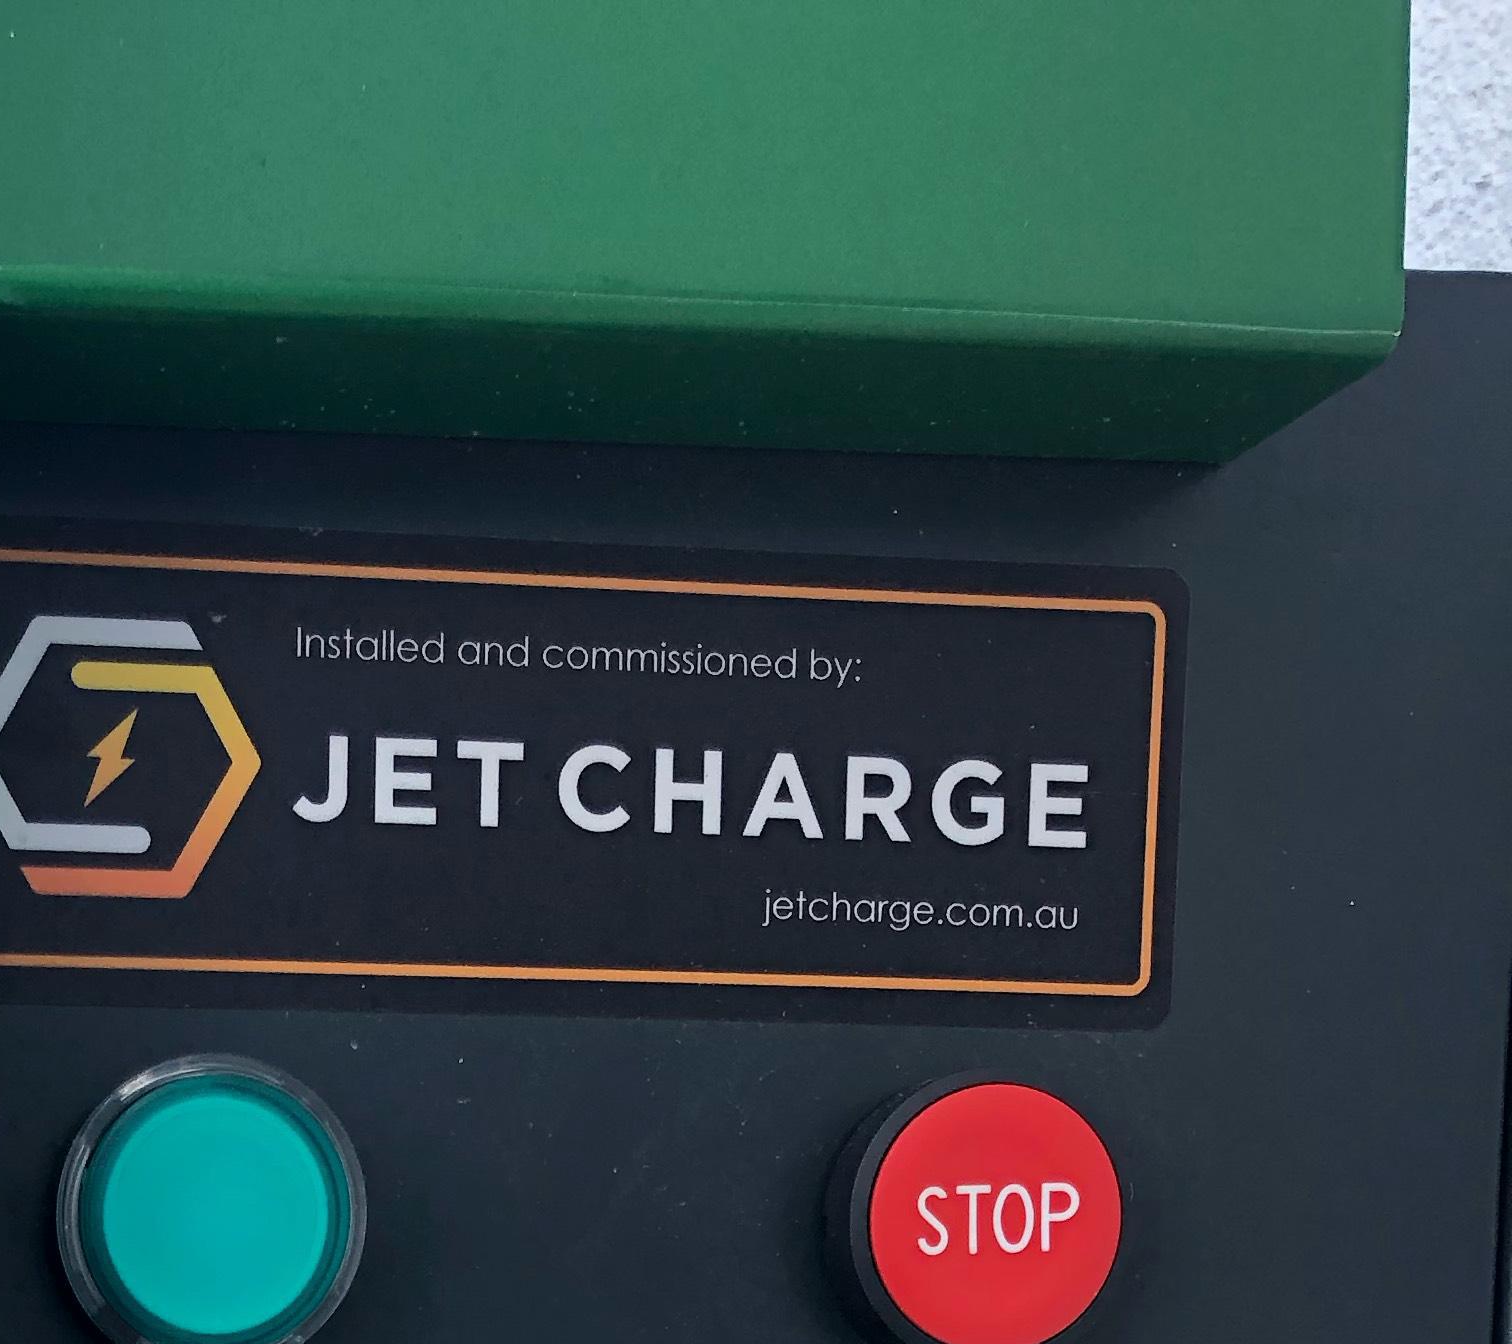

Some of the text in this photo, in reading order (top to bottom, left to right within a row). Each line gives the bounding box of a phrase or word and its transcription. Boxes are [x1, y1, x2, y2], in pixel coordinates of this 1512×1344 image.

[296, 626, 862, 689] Installed and commissioned by:
[292, 734, 1089, 849] JET CHARGE
[761, 888, 1078, 931] jetcharge.com.au
[917, 1182, 1080, 1256] STOP
